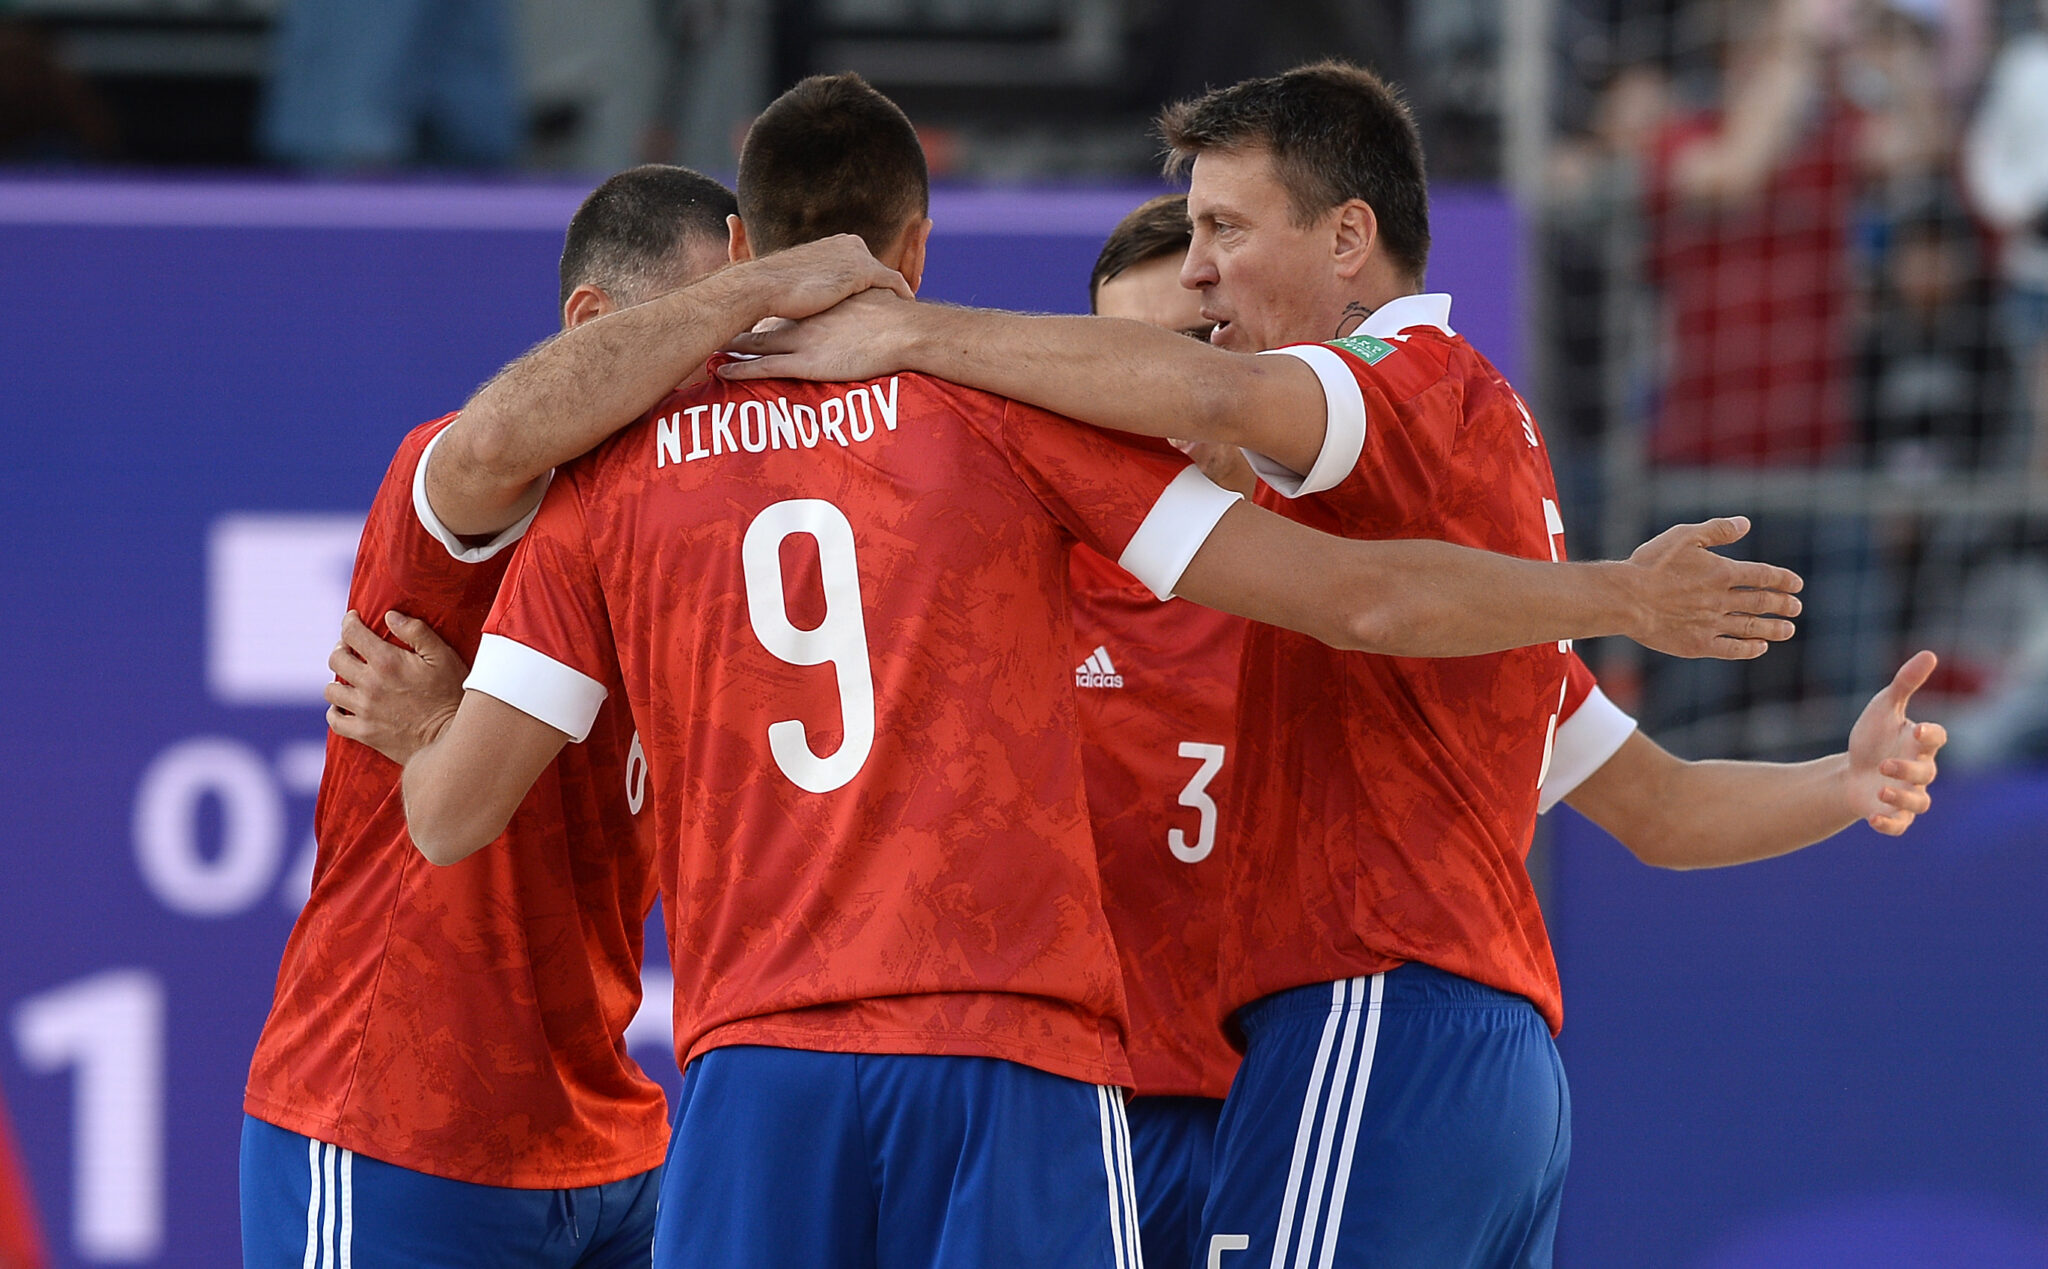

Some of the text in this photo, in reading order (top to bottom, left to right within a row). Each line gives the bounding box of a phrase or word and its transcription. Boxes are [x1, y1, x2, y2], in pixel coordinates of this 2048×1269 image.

[656, 376, 900, 469] NIKONOROV
[742, 498, 876, 794] 9
[1075, 671, 1124, 689] didas
[135, 737, 326, 916] 0
[1167, 741, 1226, 864] 3
[13, 970, 163, 1261] 1
